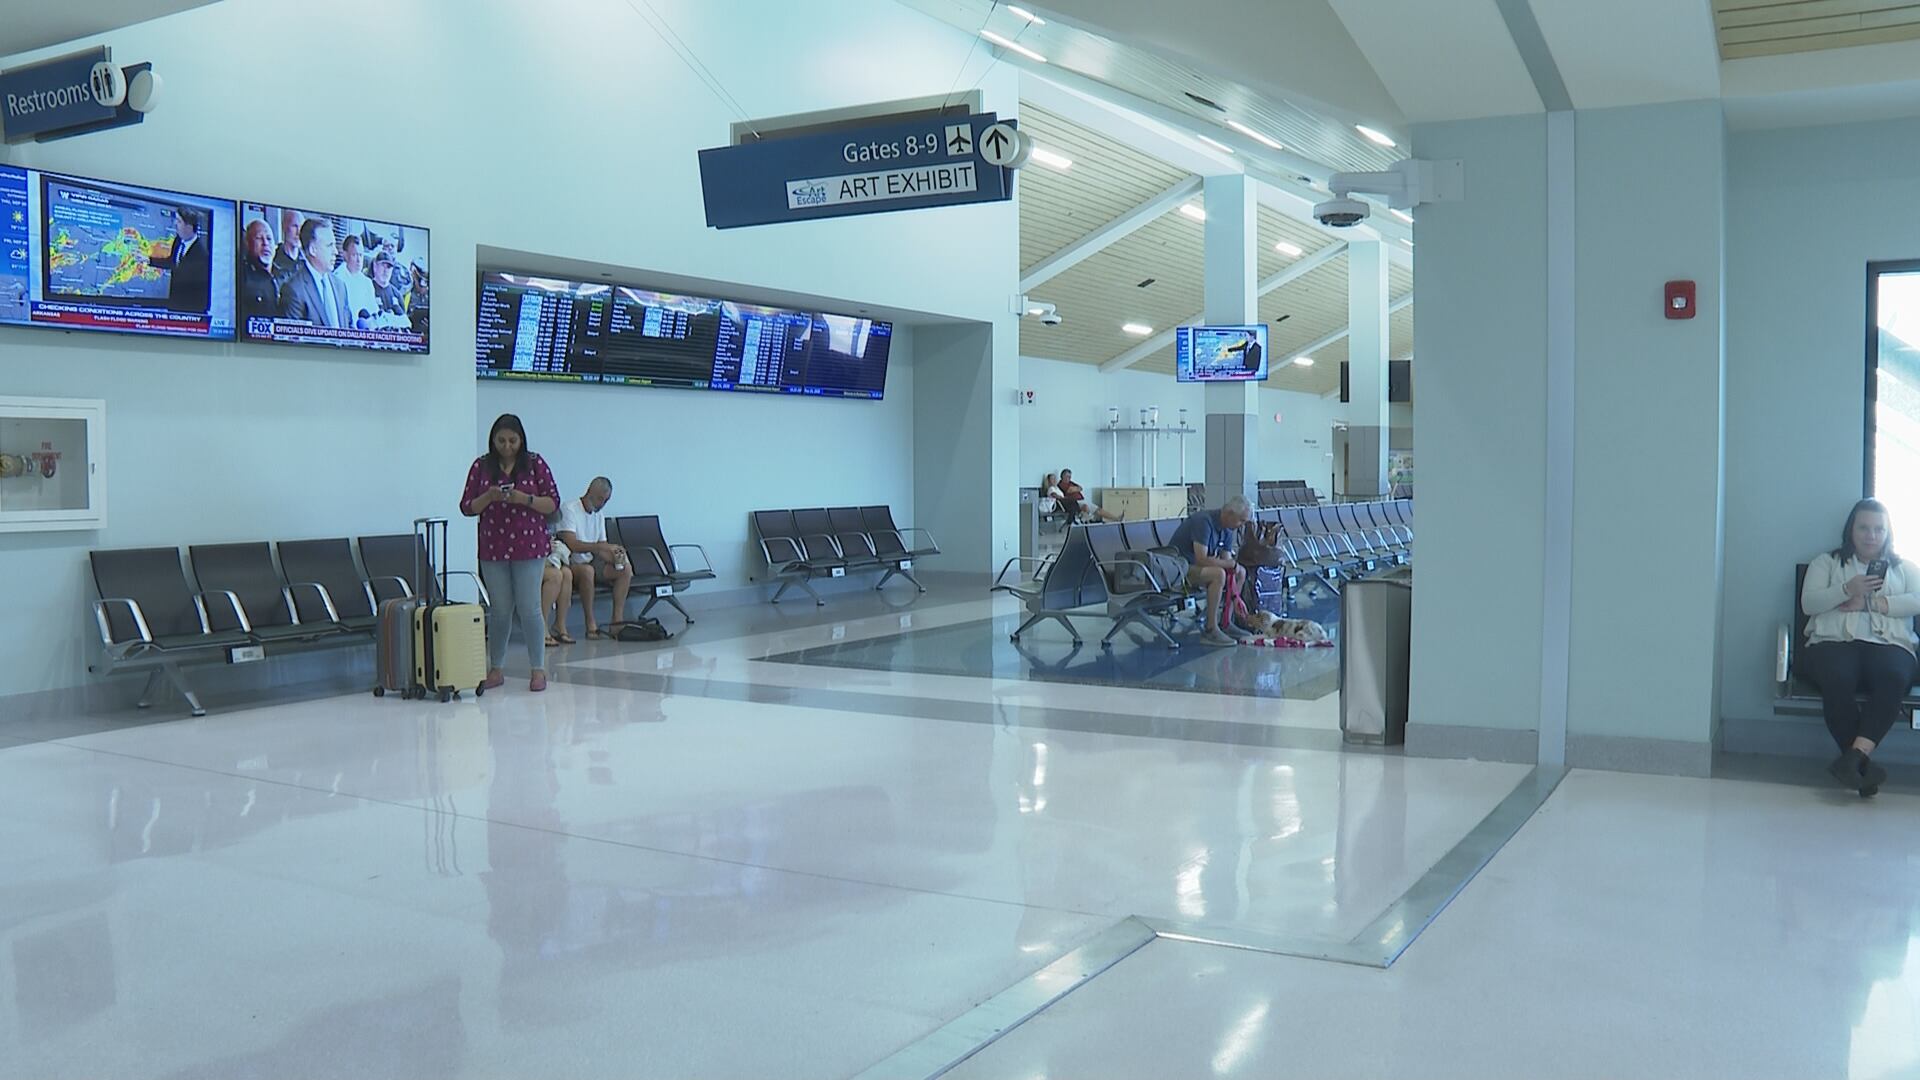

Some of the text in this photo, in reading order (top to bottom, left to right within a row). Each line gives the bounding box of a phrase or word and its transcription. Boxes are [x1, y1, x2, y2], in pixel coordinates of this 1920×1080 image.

[7, 82, 90, 117] Restrooms
[843, 133, 938, 163] Gates 8-9
[839, 166, 972, 200] ART EXHIBIT
[808, 186, 826, 199] Art
[796, 195, 827, 207] Escape
[32, 310, 61, 318] ARKANSAS
[38, 303, 78, 312] CHECKING
[79, 306, 124, 316] CONDITIONS
[124, 310, 154, 319] ACROSS
[169, 314, 201, 323] COUNTRY
[251, 322, 272, 334] FOX
[275, 325, 304, 335] OFFICIALS
[304, 328, 317, 336] GIVE
[317, 329, 338, 338] UPDATE
[338, 330, 347, 338] ON
